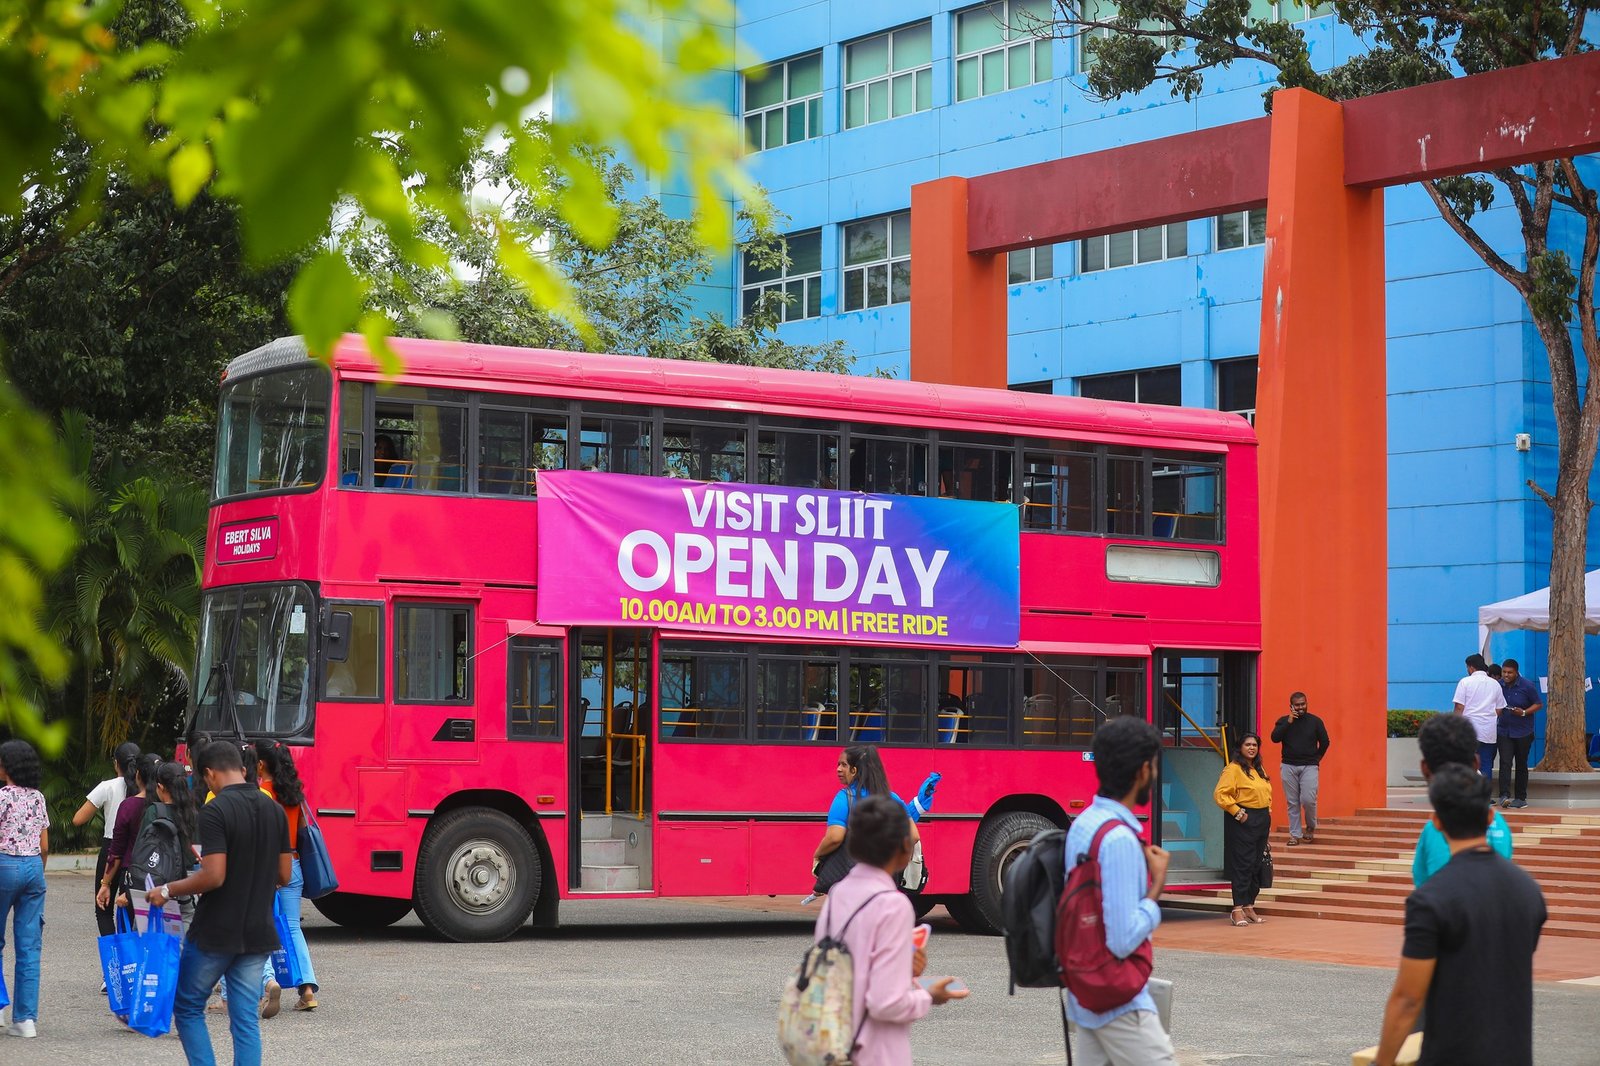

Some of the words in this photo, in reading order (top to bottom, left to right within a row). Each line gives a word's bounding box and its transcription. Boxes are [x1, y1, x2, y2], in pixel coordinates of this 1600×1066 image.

[681, 488, 788, 533] VISIT
[795, 495, 893, 540] SLIIT
[224, 529, 249, 545] EBERT
[250, 526, 271, 541] SILVA
[233, 542, 261, 555] HOLIDAYS
[617, 529, 799, 601] OPEN
[813, 541, 950, 608] DAY
[620, 597, 716, 625] 10.00AM
[720, 604, 751, 626] TO
[754, 605, 802, 629] 3.00
[903, 614, 949, 637] RIDE
